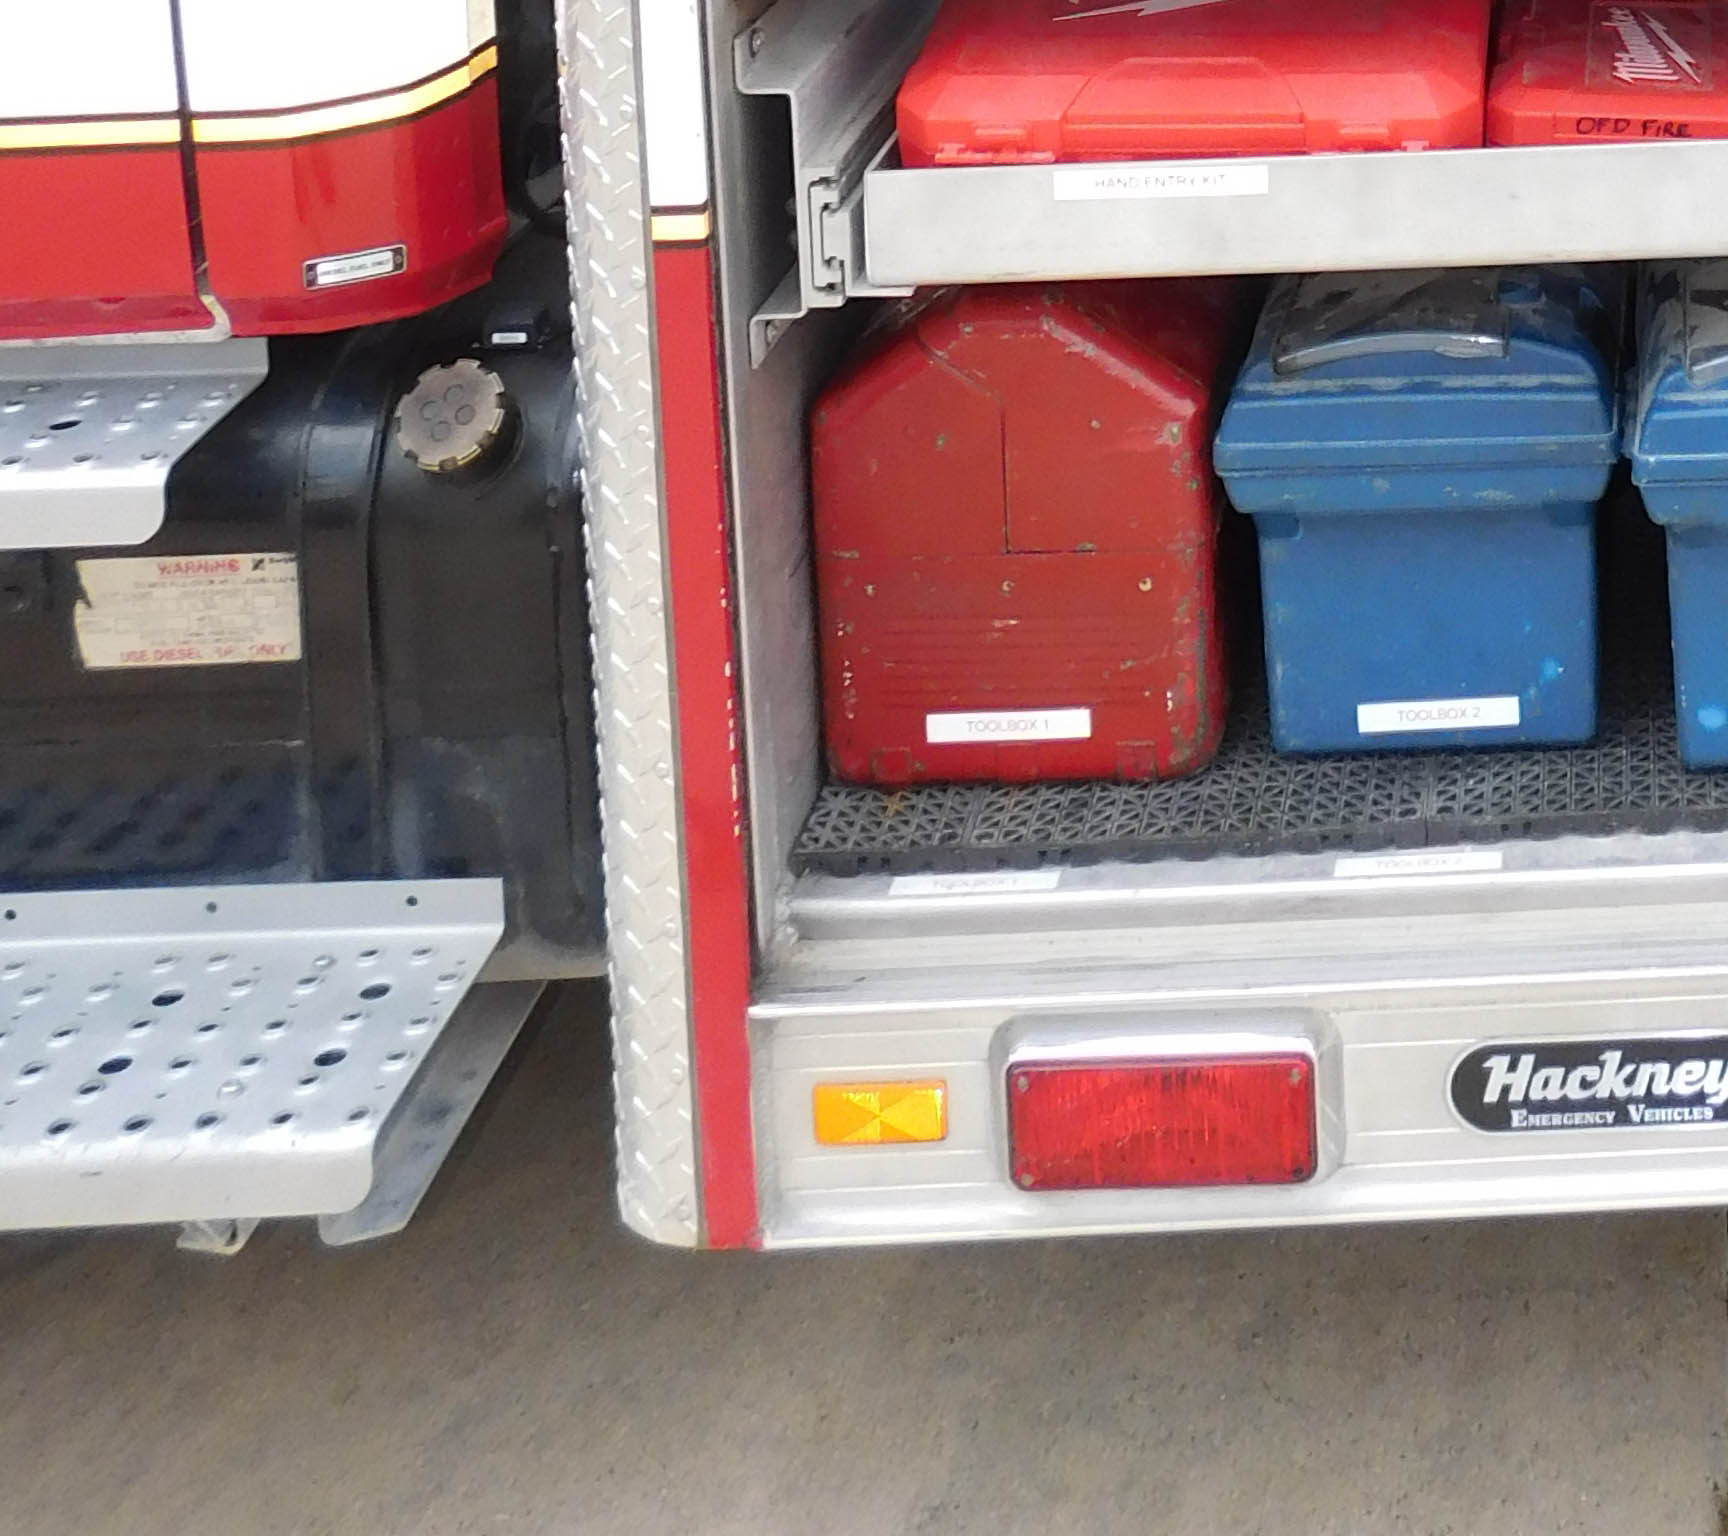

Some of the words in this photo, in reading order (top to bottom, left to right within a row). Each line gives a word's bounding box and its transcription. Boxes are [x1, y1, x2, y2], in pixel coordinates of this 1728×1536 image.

[1602, 6, 1681, 85] Milwaukee
[1576, 116, 1631, 135] OFD
[1641, 119, 1693, 138] FIRE
[1094, 177, 1138, 189] HAND
[1144, 174, 1196, 188] ENTRY
[1202, 174, 1225, 186] KIT
[1397, 707, 1468, 723] TOOLBOX
[1472, 706, 1481, 719] 2
[966, 719, 1038, 733] TOOLBOX
[1510, 1108, 1617, 1128] EMERGENCY
[1627, 1103, 1715, 1123] VEHICLES
